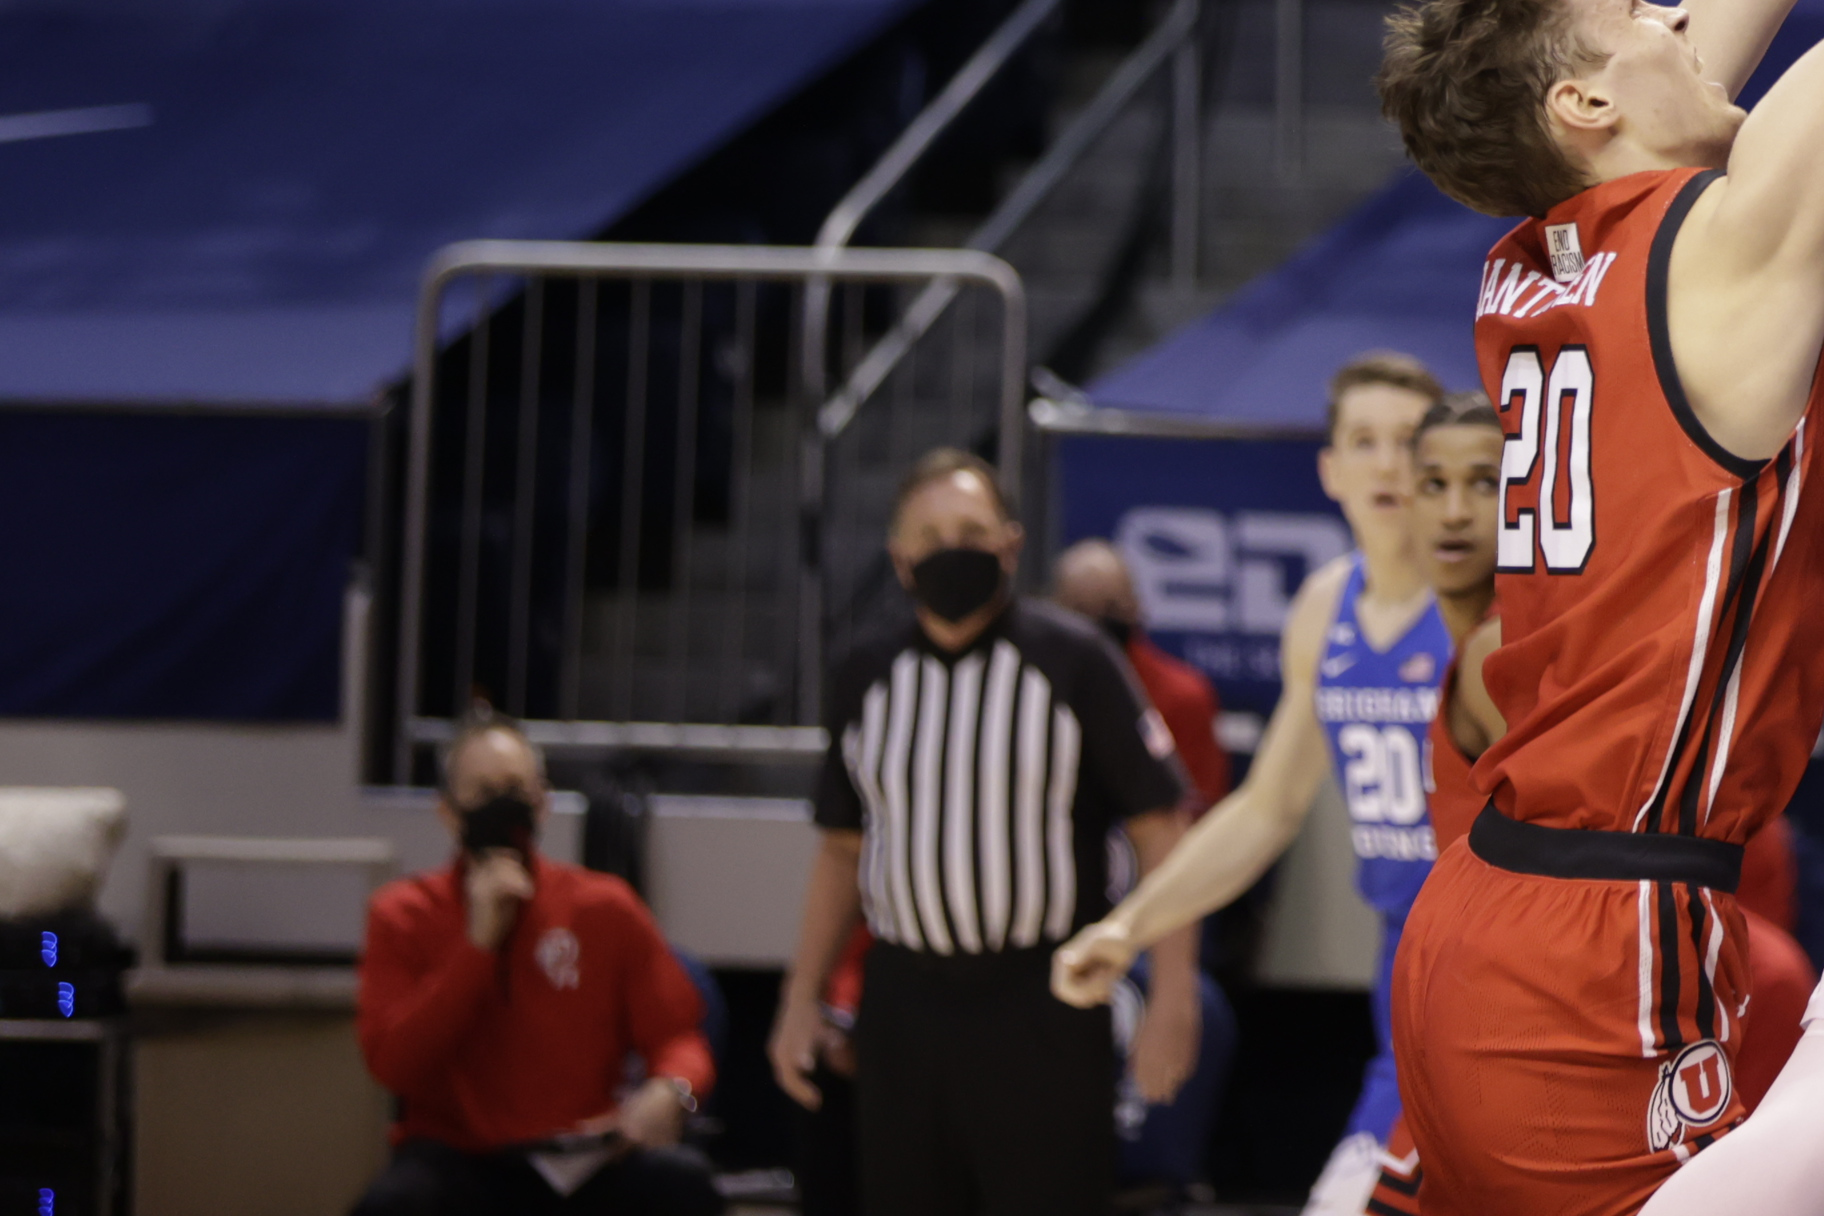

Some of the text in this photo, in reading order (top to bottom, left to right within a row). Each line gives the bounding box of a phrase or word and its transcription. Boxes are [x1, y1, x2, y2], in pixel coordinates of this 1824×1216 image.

[1550, 251, 1586, 276] RACISM
[1553, 230, 1570, 252] END
[1496, 344, 1596, 575] 20
[1338, 724, 1427, 825] 20
[1679, 1050, 1722, 1115] U
